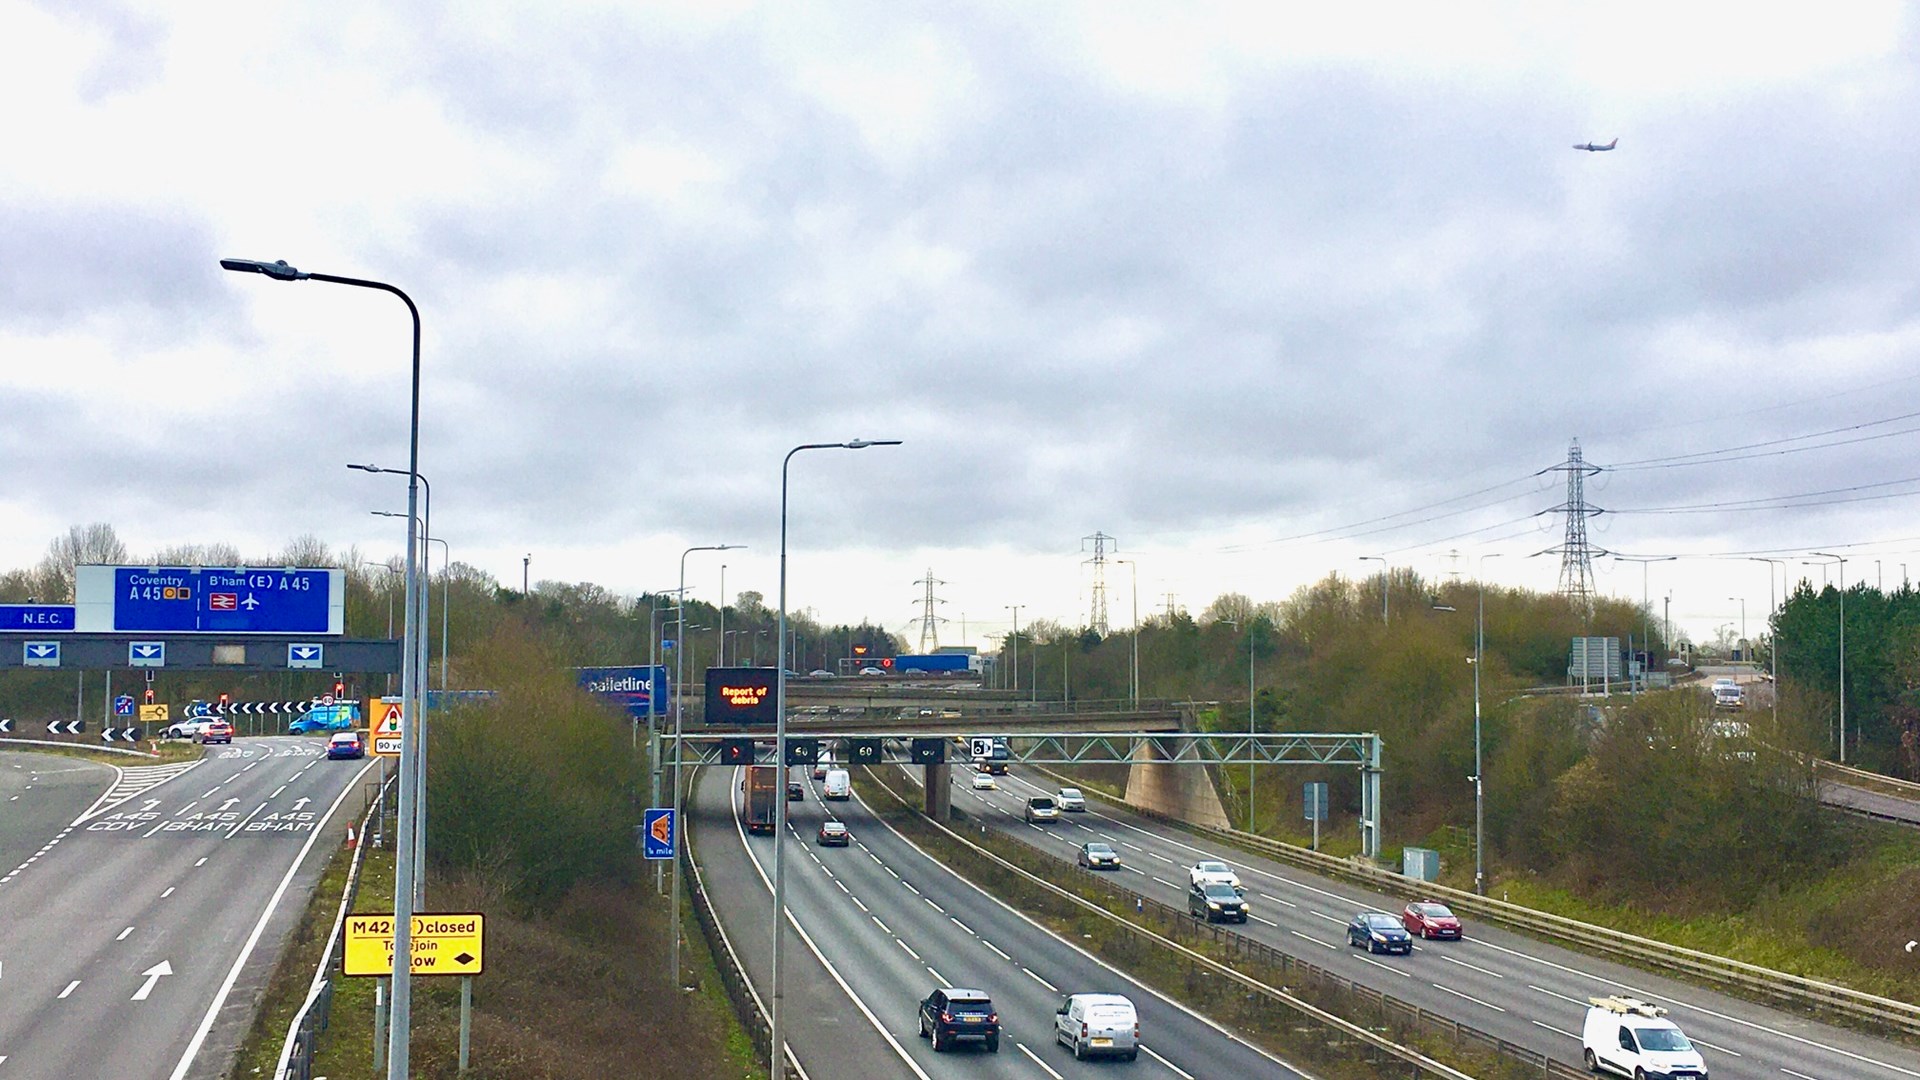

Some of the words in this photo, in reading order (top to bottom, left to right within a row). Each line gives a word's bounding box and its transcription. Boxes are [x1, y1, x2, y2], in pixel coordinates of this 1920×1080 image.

[130, 574, 184, 587] Coventry
[209, 575, 246, 587] B'ham
[248, 574, 273, 589] (E)
[23, 612, 62, 624] N.E.C.
[722, 687, 754, 697] Report
[756, 686, 767, 696] of
[731, 695, 759, 704] debris
[378, 741, 390, 749] 90
[859, 747, 873, 756] 60
[104, 812, 161, 820] A45
[186, 812, 240, 820] A45
[263, 812, 316, 820] A45
[86, 821, 147, 831] COV
[163, 821, 237, 831] BHAM
[244, 821, 316, 831] BHAM
[656, 847, 673, 855] mile
[353, 921, 390, 934] M42
[425, 920, 475, 933] closed
[387, 954, 436, 967] flow
